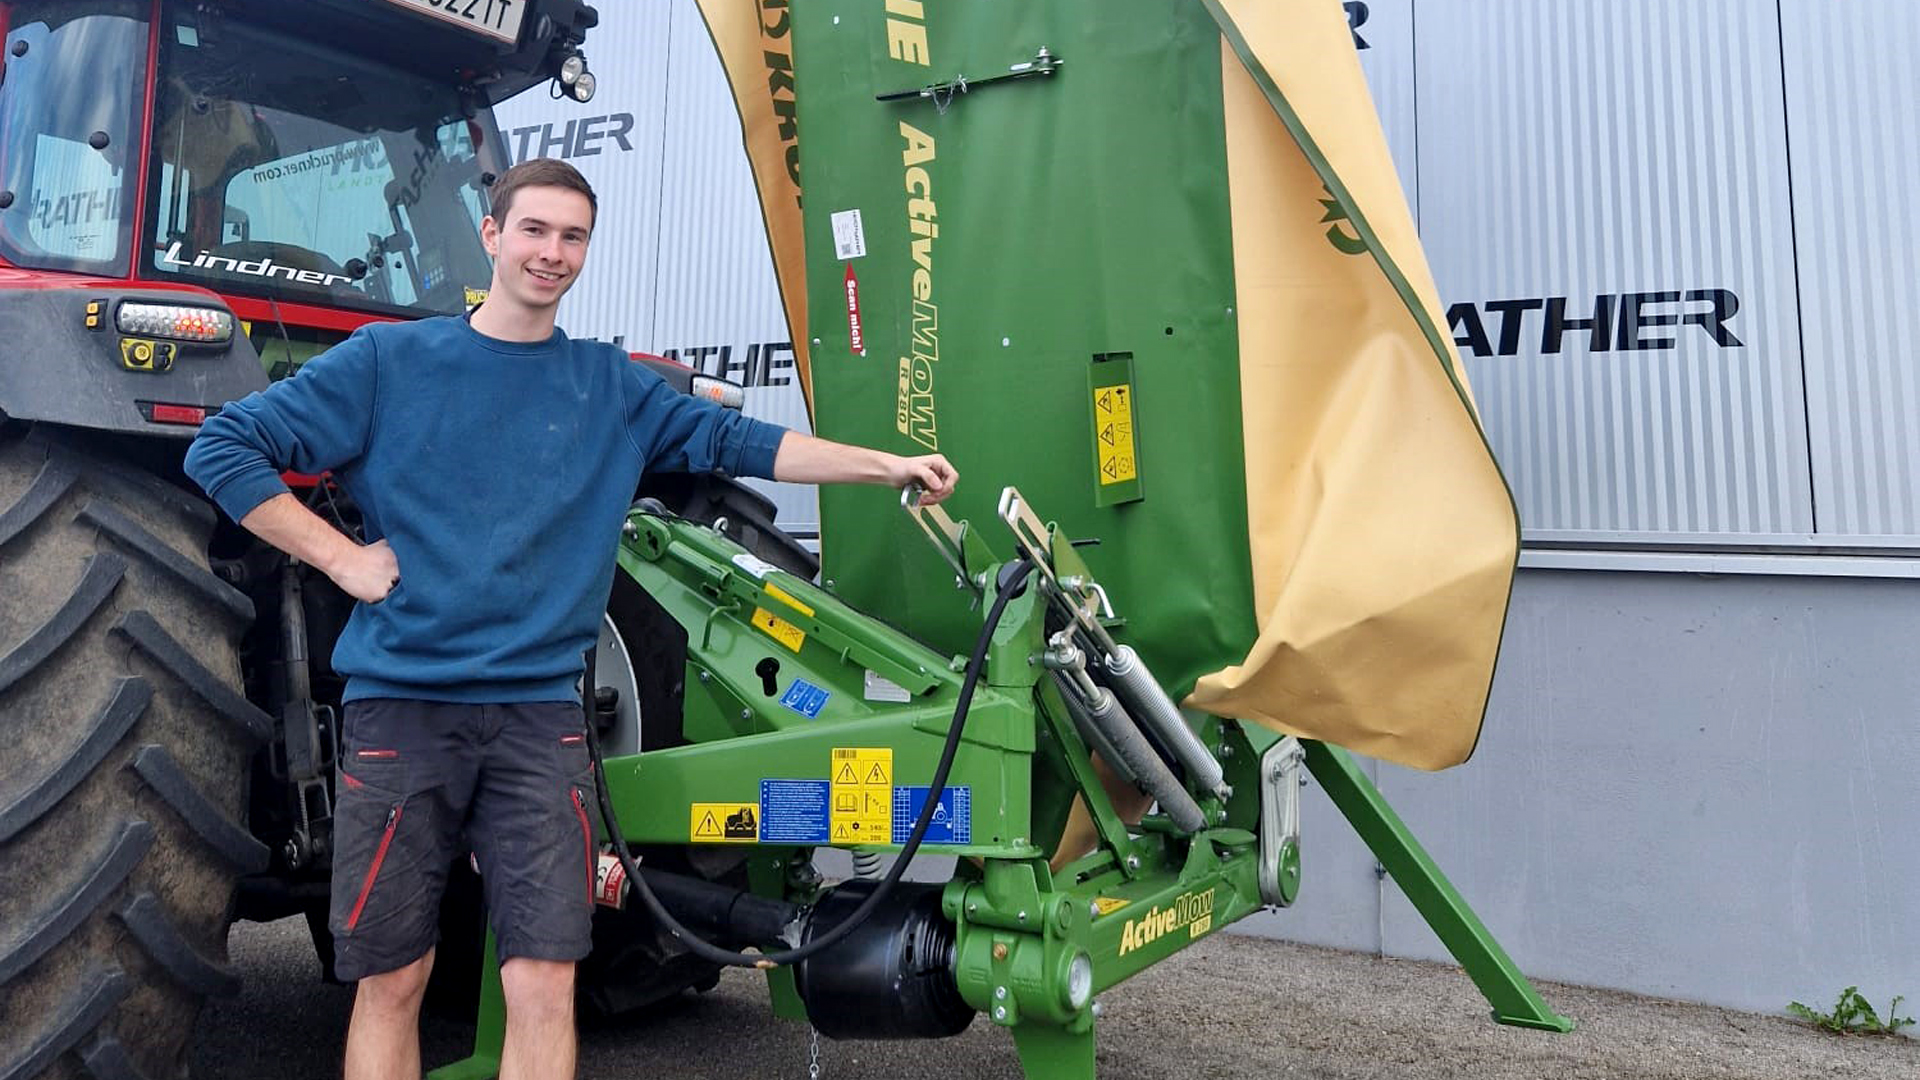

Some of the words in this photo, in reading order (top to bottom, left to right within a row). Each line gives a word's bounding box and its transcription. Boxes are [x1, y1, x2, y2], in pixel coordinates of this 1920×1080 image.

[500, 112, 635, 166] THER
[163, 241, 352, 287] Lindner
[846, 279, 857, 311] Scan
[850, 314, 862, 349] mich!
[1446, 288, 1745, 357] ATHER
[900, 366, 909, 380] R
[898, 389, 910, 425] 280
[1119, 887, 1215, 957] ActiveMow
